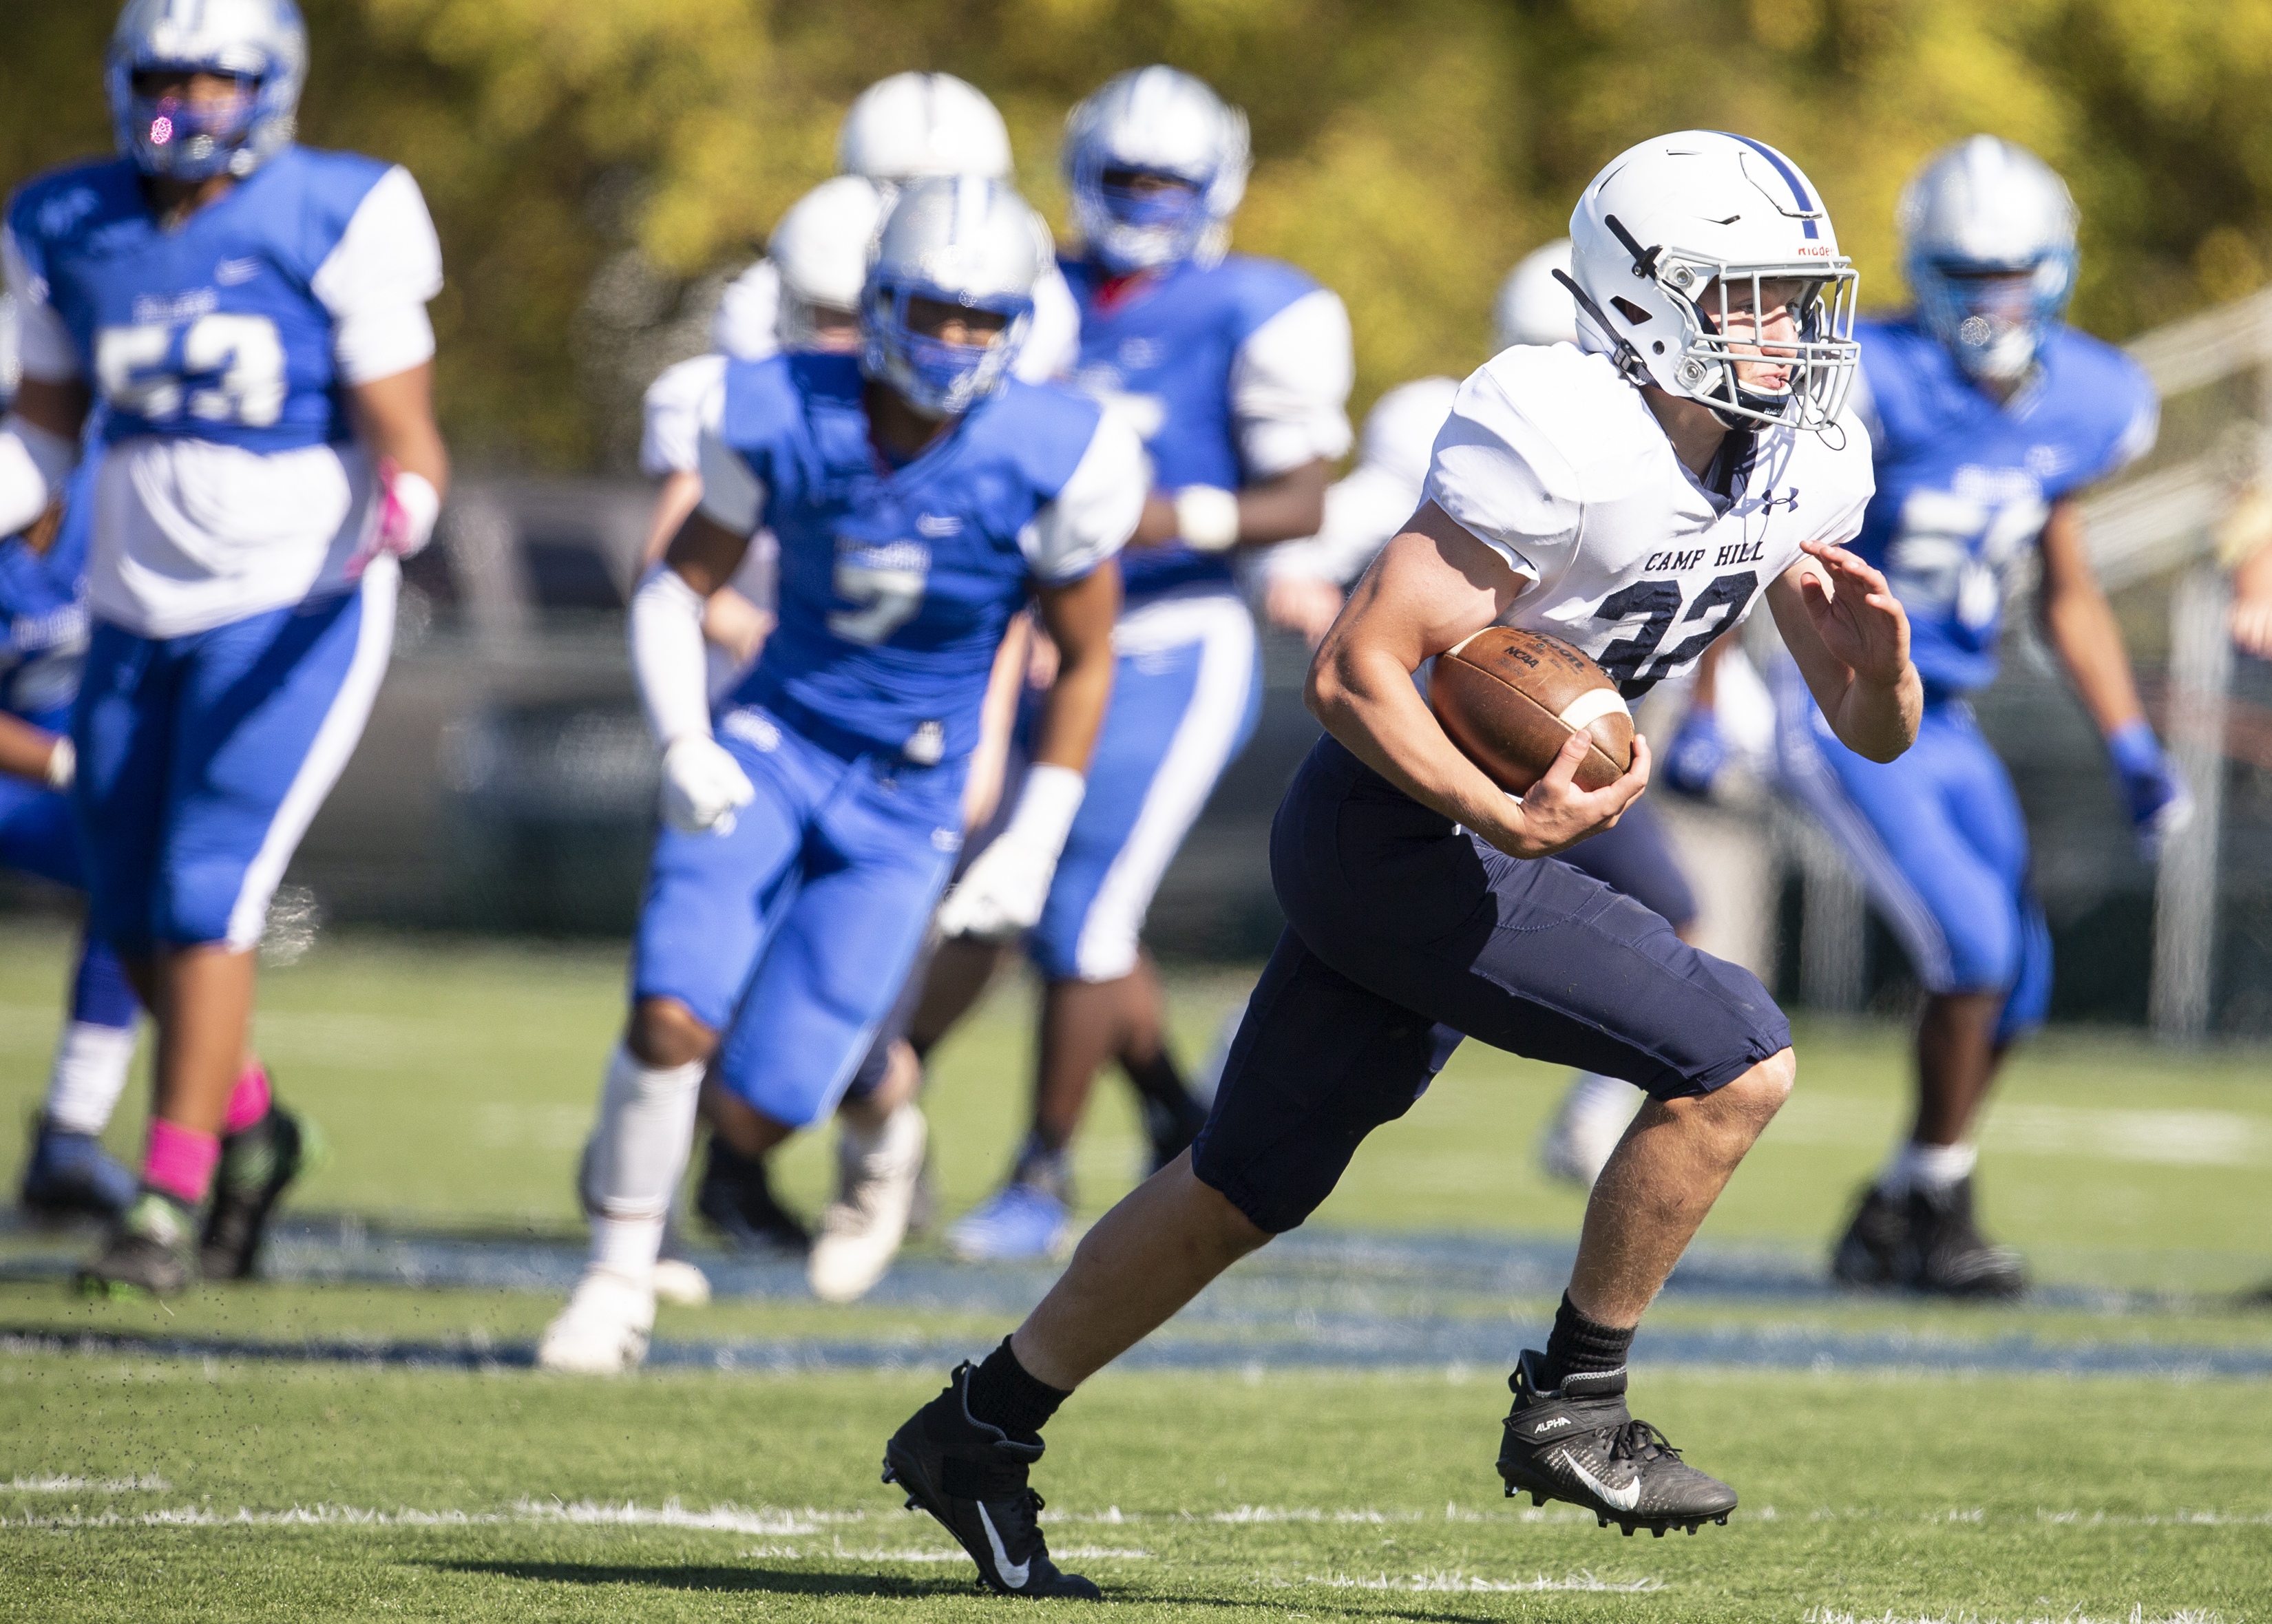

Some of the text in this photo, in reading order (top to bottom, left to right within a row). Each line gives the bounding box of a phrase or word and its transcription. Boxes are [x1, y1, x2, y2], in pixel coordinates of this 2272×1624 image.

[1644, 541, 1764, 571] CAMP HILL
[1504, 646, 1539, 668] NCAA
[1534, 1416, 1571, 1434] ALPHA
